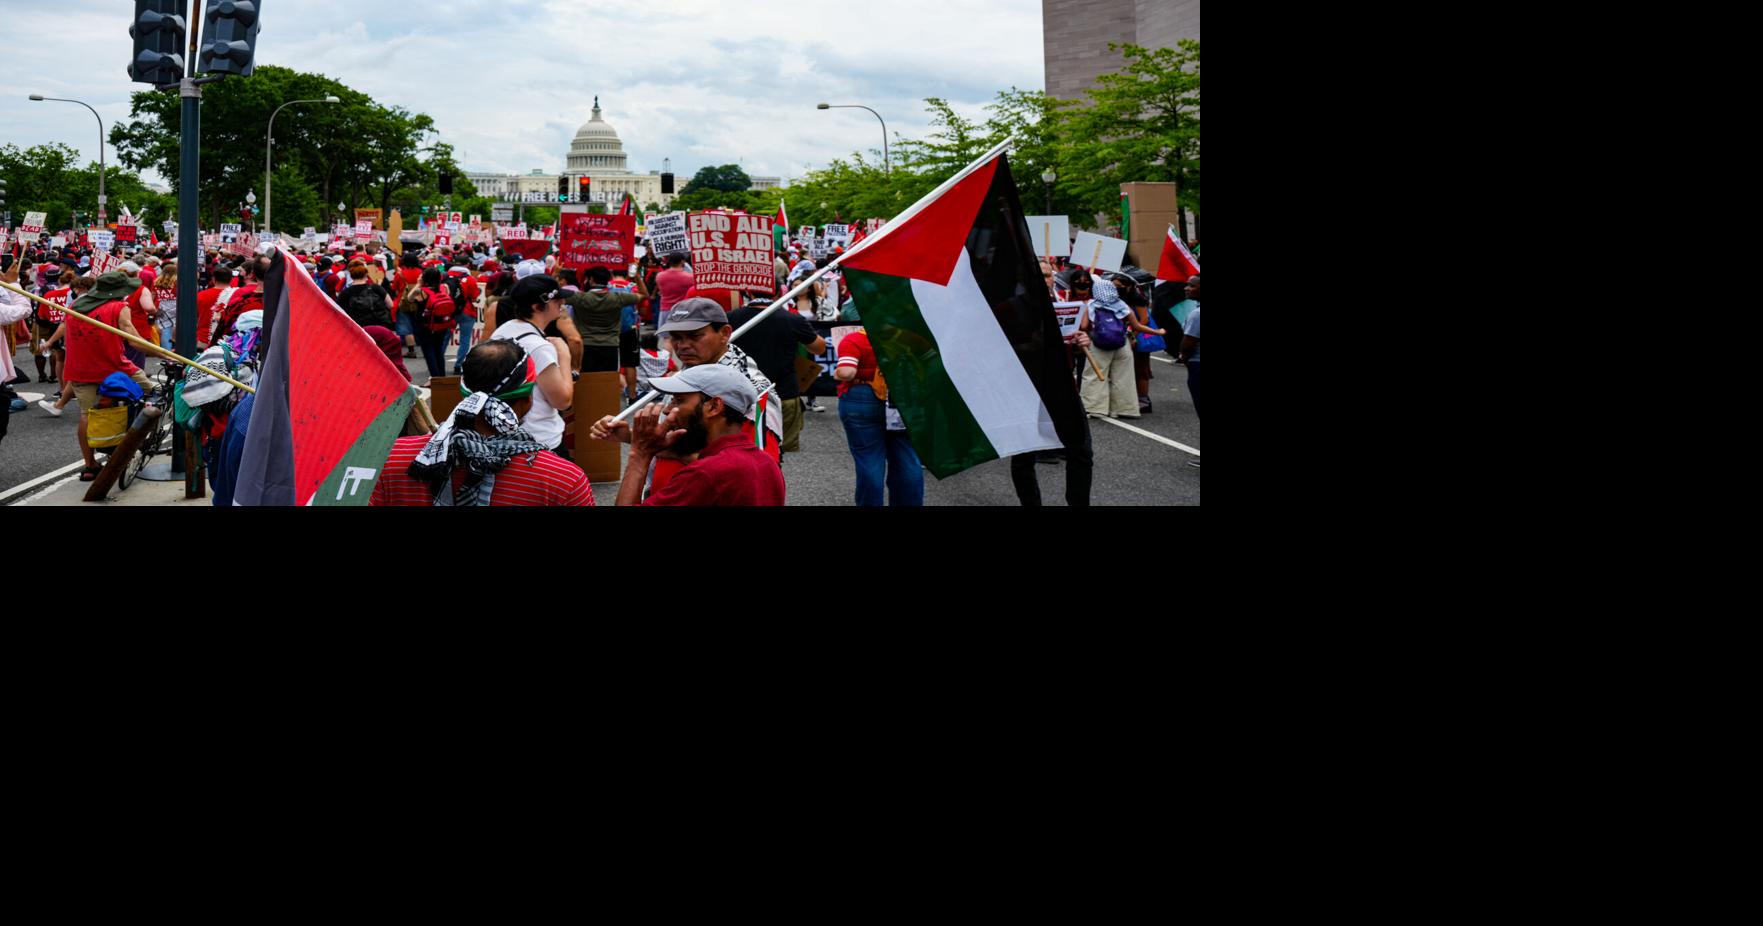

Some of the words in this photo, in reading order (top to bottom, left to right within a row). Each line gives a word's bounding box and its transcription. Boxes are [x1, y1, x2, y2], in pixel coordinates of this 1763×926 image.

[522, 192, 546, 202] FREE
[650, 226, 684, 236] OCCUPATION
[690, 215, 730, 232] END
[736, 216, 772, 234] ALL
[572, 239, 622, 251] MASS
[655, 239, 687, 252] RIGHT!
[691, 231, 730, 248] U.S.
[735, 233, 771, 250] AID
[692, 248, 713, 262] TO
[717, 249, 772, 265] ISRAEL
[694, 262, 715, 273] STOP
[717, 263, 732, 272] THE
[734, 264, 772, 276] GENOCIDE
